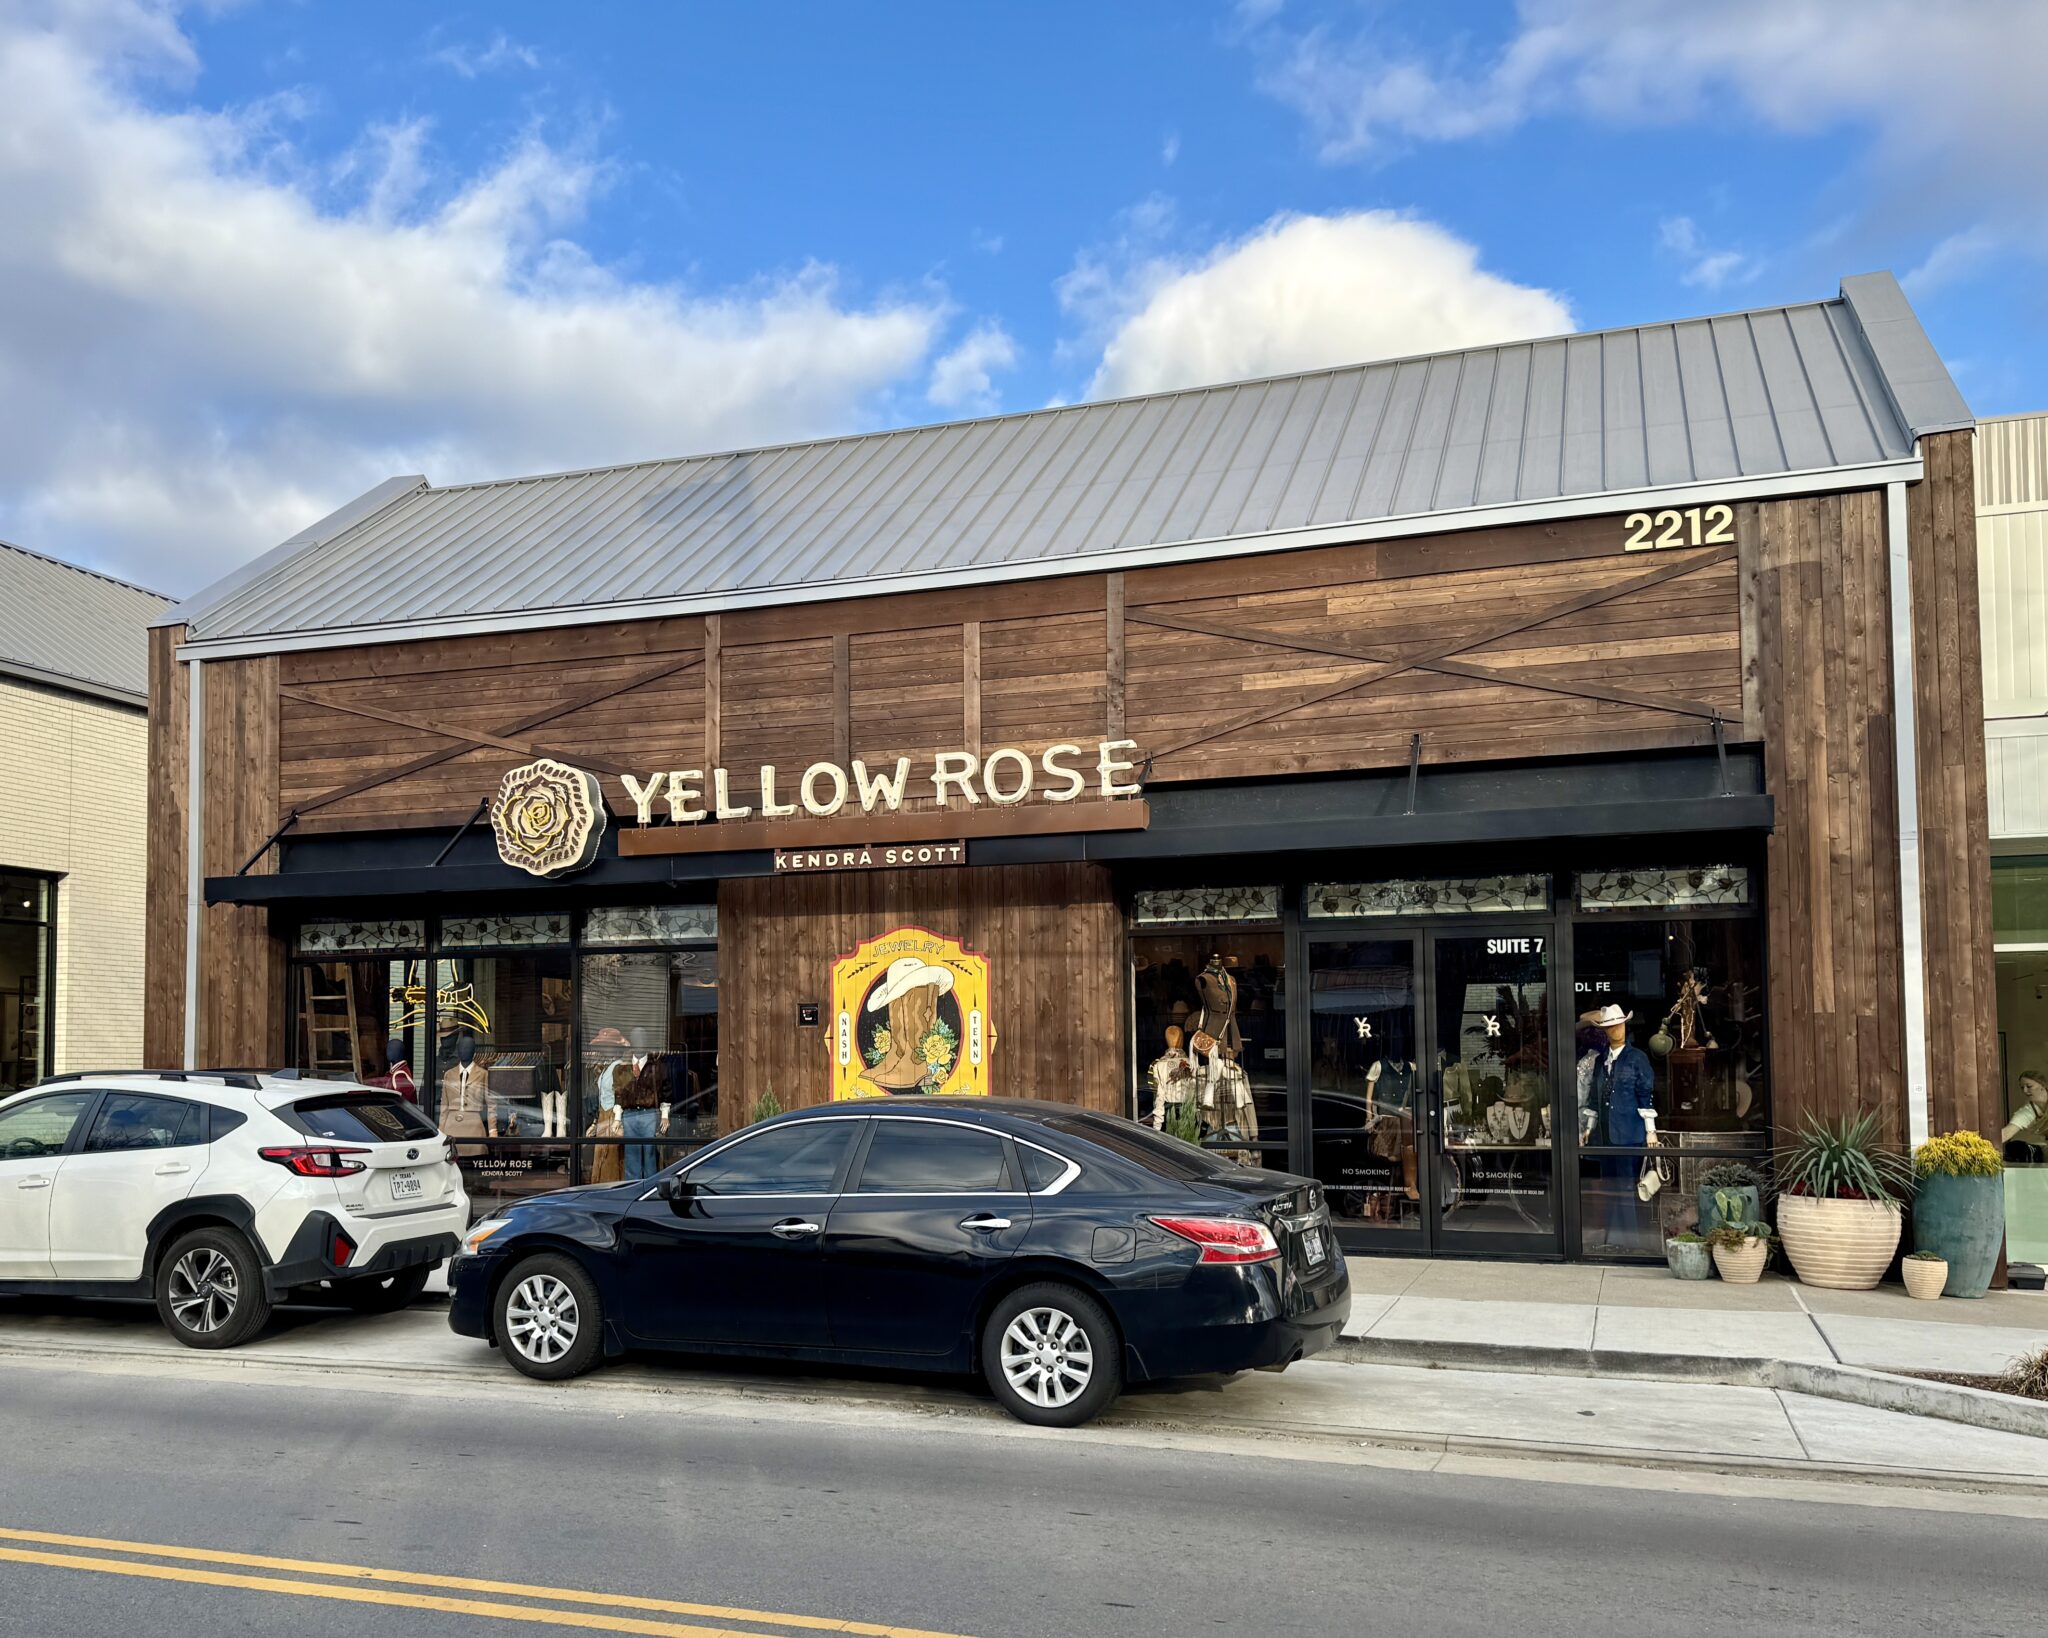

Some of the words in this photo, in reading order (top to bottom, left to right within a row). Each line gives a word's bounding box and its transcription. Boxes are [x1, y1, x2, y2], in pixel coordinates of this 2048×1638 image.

[1624, 504, 1735, 552] 2212
[619, 756, 912, 824] YELLOW
[930, 738, 1142, 806] ROSE
[775, 850, 873, 870] KENDRA
[885, 846, 961, 864] SCOTT
[872, 939, 946, 958] JEWELRY
[1486, 938, 1530, 954] SUITE
[1533, 938, 1544, 953] 7
[472, 1160, 507, 1168] YELLOW
[509, 1160, 533, 1168] ROSE
[1355, 1168, 1390, 1176] SMOKING
